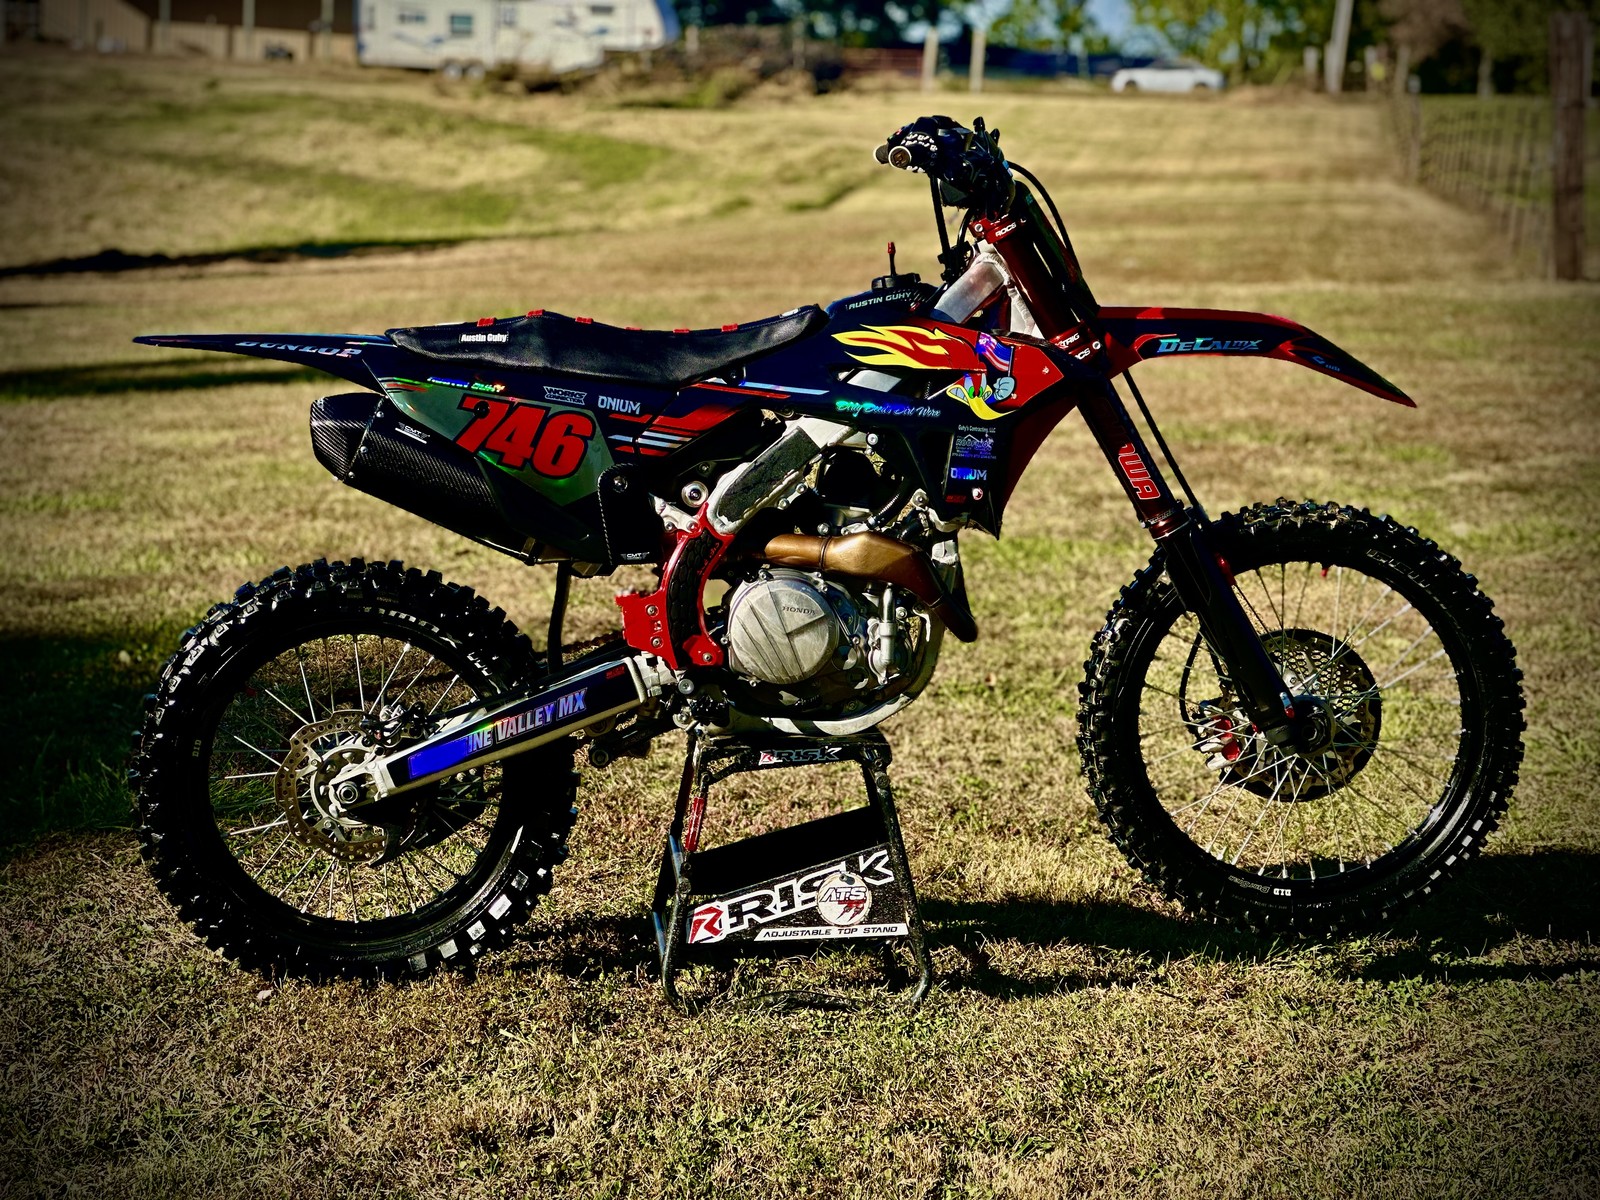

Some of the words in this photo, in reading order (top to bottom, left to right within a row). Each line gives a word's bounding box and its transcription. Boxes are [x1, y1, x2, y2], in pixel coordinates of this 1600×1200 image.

[848, 298, 883, 310] AUSTIN
[885, 292, 912, 302] GUHY
[461, 333, 487, 342] Austin
[487, 333, 508, 343] Guhy
[235, 341, 362, 358] DUNLOP
[597, 395, 640, 415] ONIUM
[454, 394, 595, 478] 746
[950, 467, 988, 481] OUM
[782, 605, 816, 616] HONDA
[496, 703, 554, 742] VALLEY
[558, 688, 587, 719] MX
[763, 928, 832, 938] ADJUSTABLE
[837, 927, 858, 935] TOP
[863, 926, 898, 934] STAND
